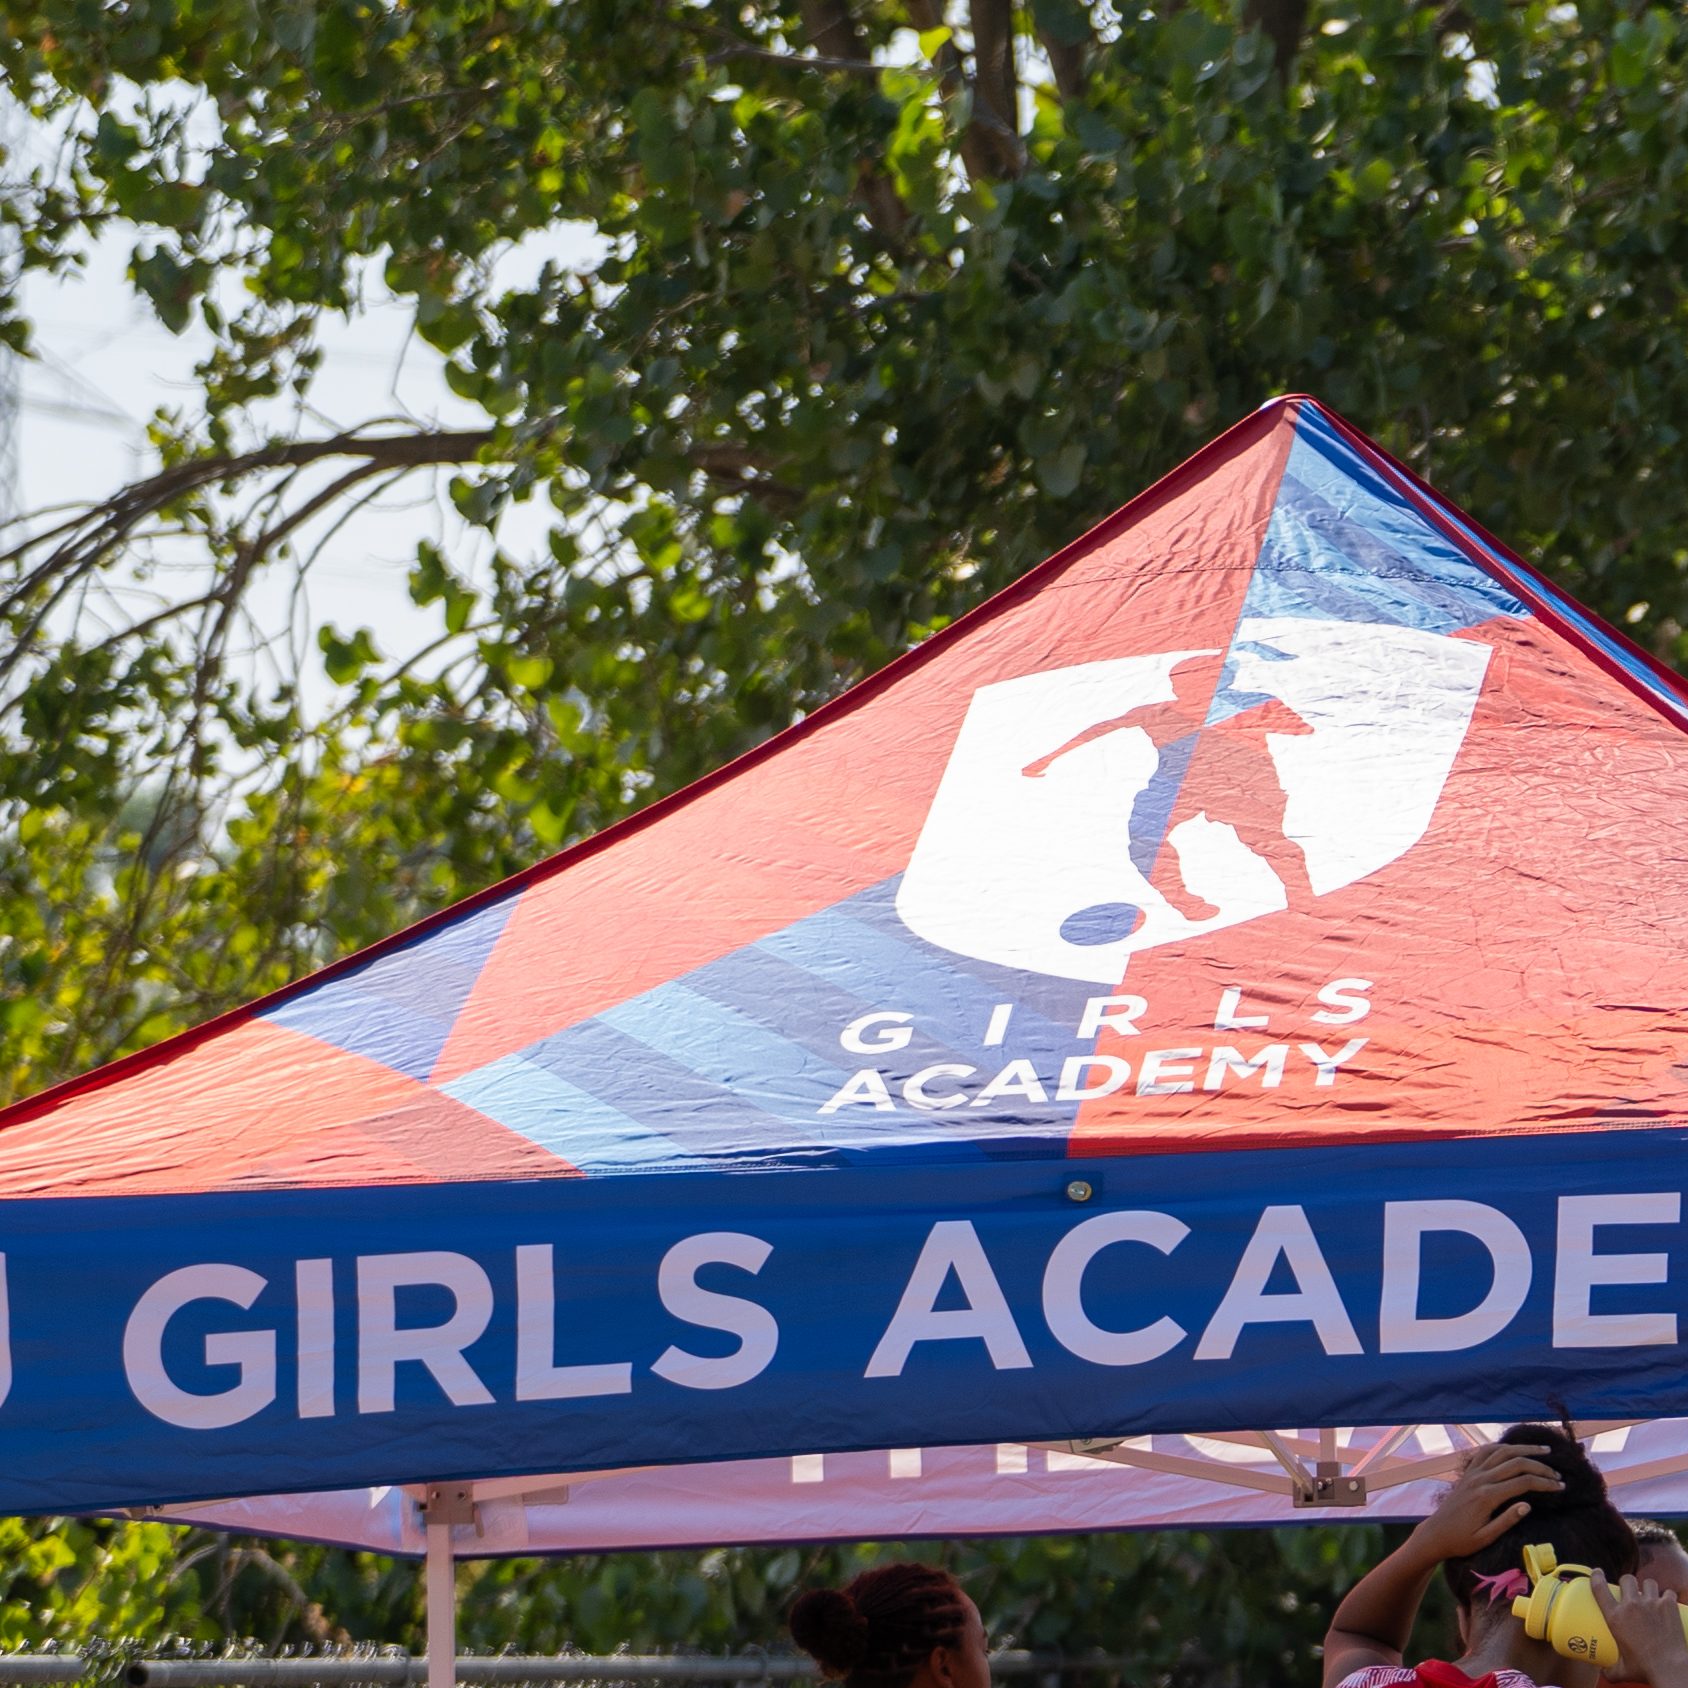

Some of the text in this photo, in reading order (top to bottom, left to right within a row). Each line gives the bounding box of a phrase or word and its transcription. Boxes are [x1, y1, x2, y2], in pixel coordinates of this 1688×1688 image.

[839, 977, 1374, 1055] GIRLS
[816, 1037, 1369, 1115] ACADEMY
[123, 1231, 780, 1431] GIRLS
